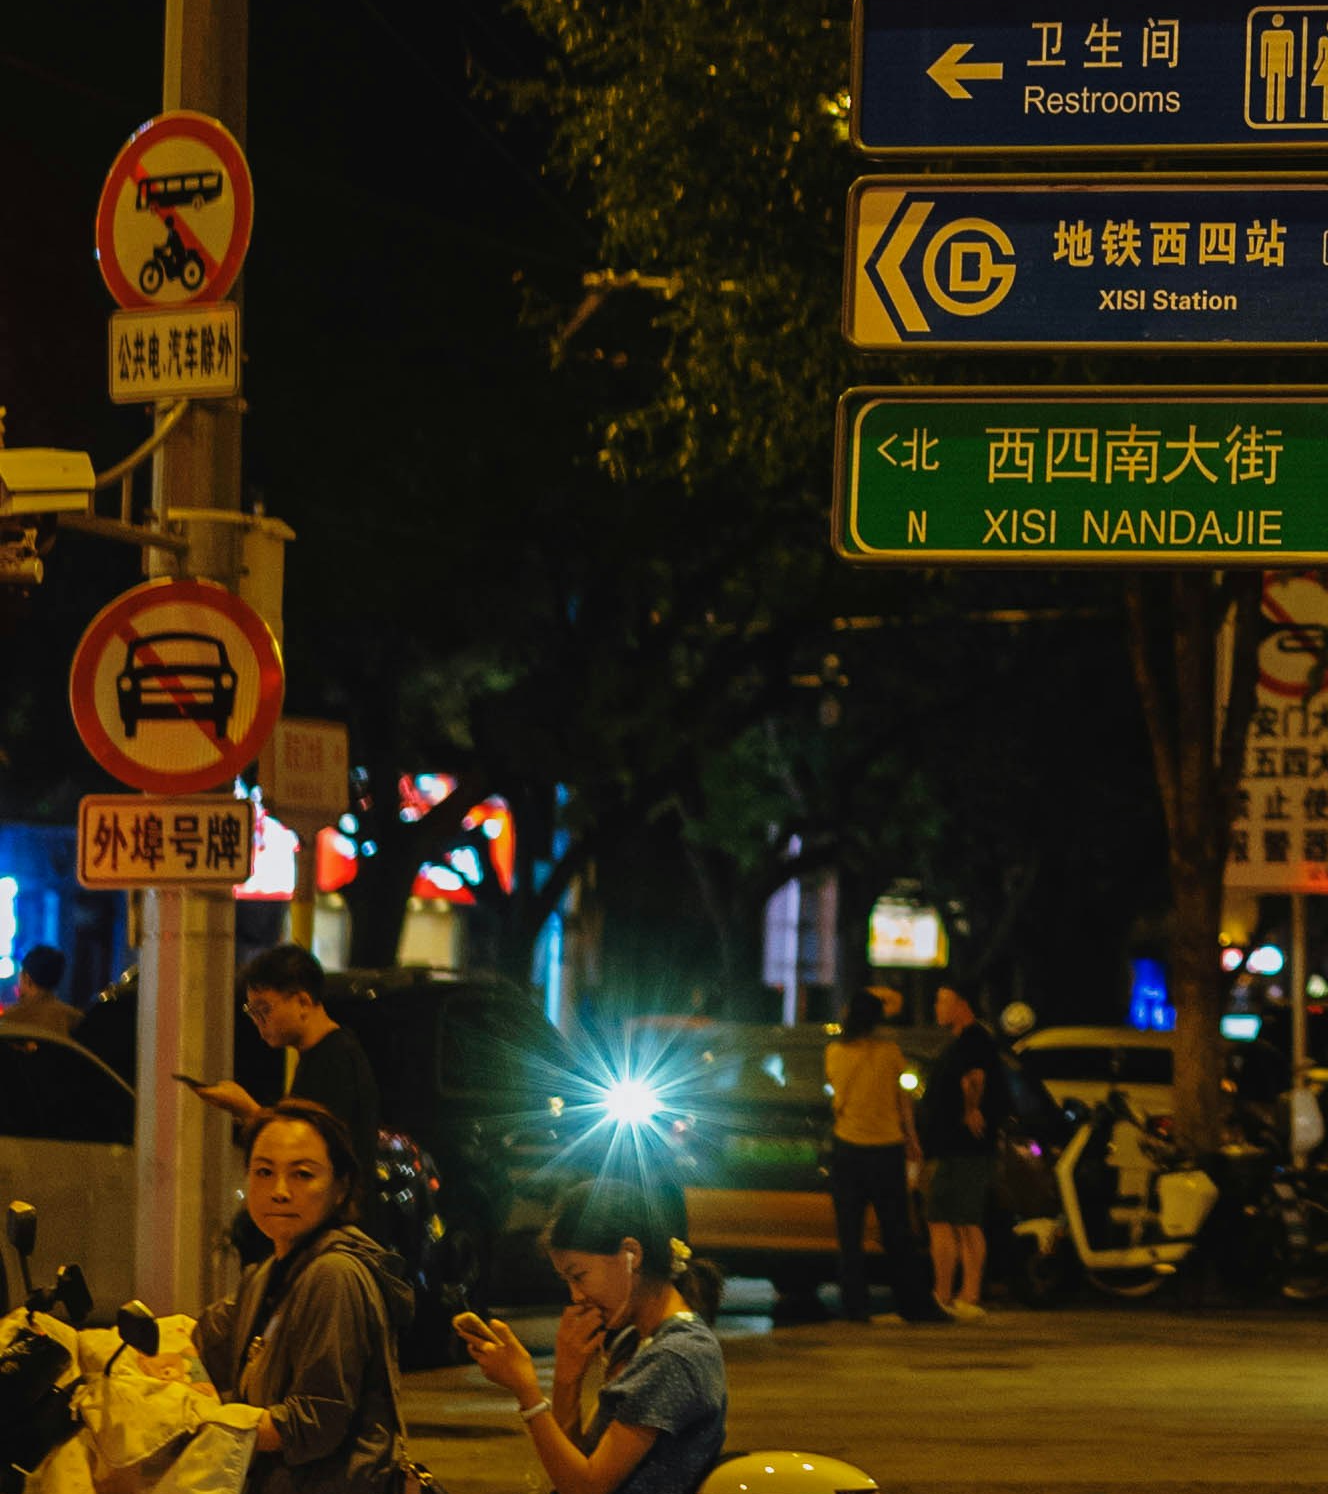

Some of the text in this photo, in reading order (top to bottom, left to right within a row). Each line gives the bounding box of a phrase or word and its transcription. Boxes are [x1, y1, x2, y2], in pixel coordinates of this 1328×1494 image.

[1025, 18, 1180, 69] 卫生间
[1023, 85, 1181, 115] Restrooms
[1052, 218, 1288, 268] 地铁西四站
[1098, 289, 1238, 311] XISI Station
[118, 321, 233, 382] 公共电、汽车除外
[901, 428, 941, 472] 北
[985, 423, 1284, 485] 西四南大街
[907, 510, 928, 544] N
[982, 509, 1057, 546] XISI
[1081, 509, 1283, 546] NANDAJIE
[93, 813, 242, 871] 外埠号牌
